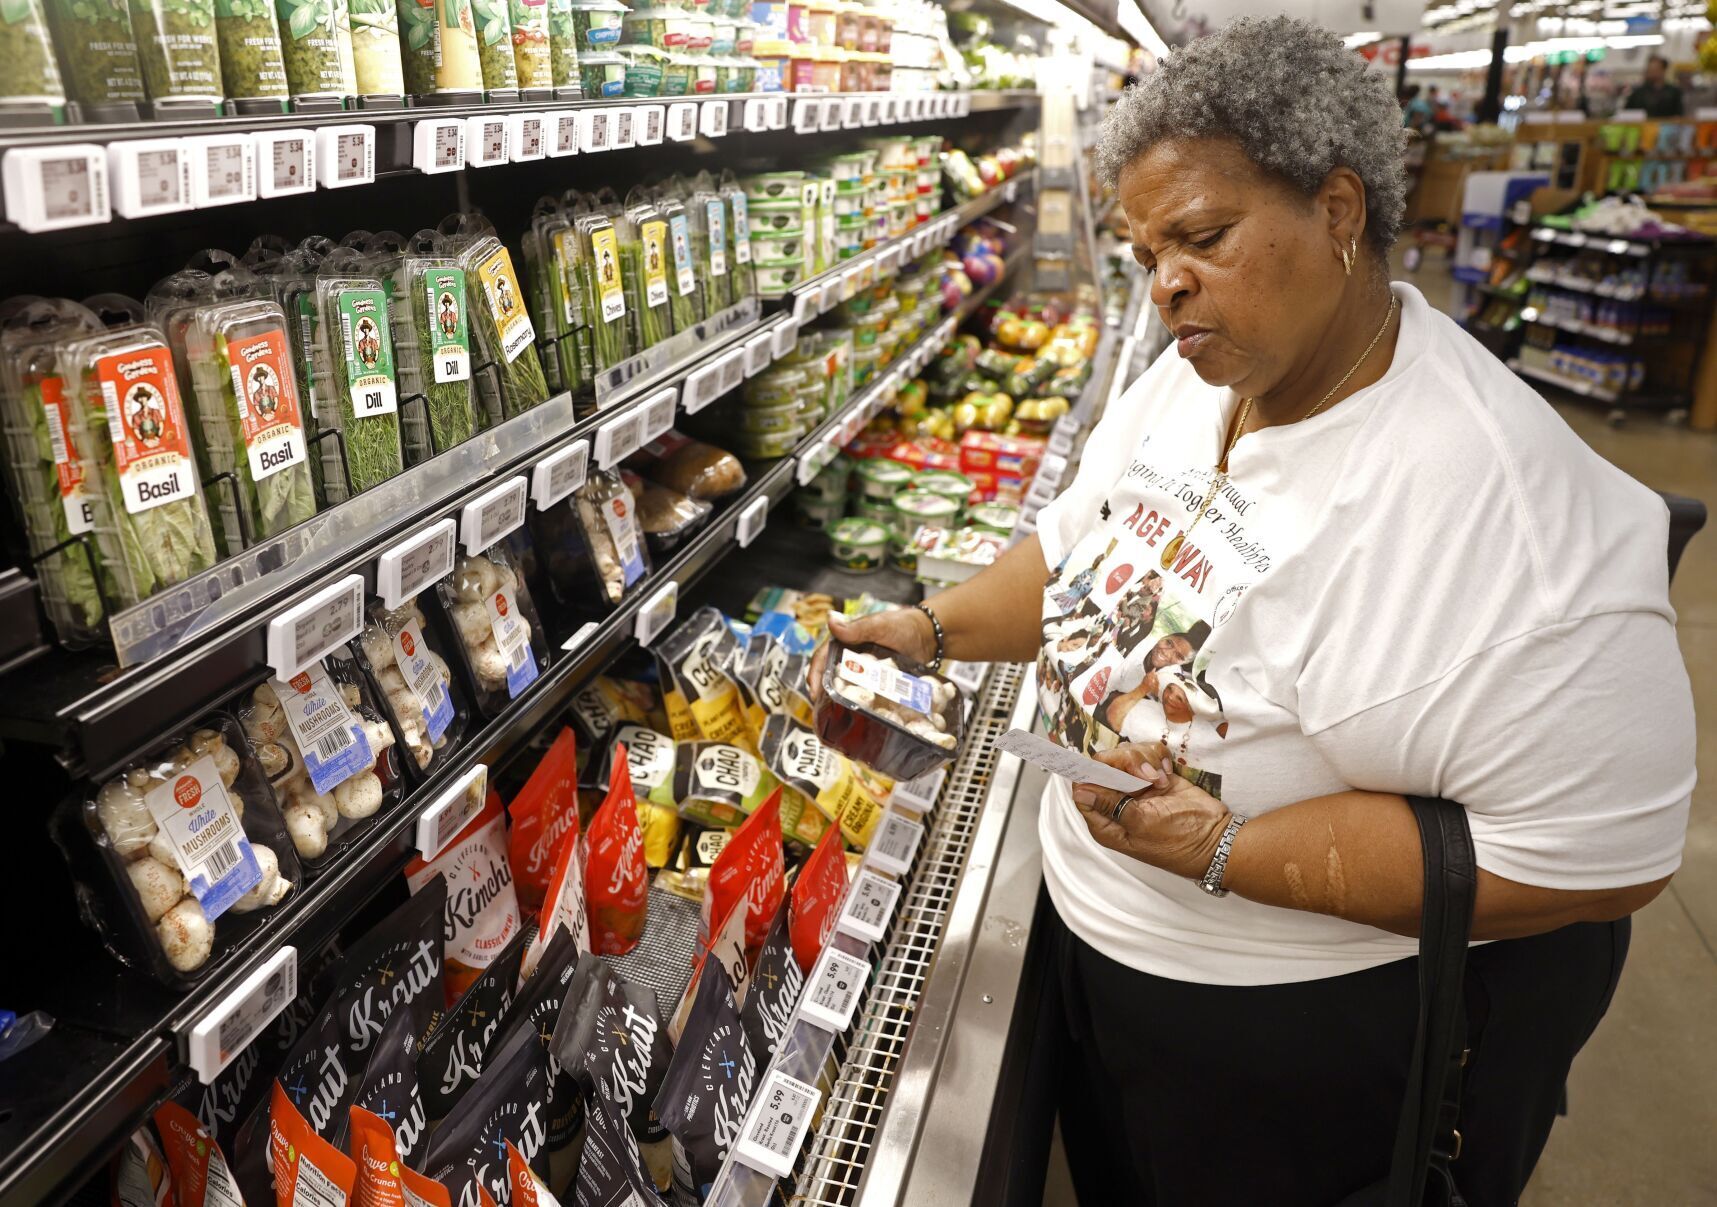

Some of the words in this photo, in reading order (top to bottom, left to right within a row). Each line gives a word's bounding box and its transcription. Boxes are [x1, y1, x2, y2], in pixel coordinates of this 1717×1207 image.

[352, 137, 364, 146] 5.34
[605, 302, 623, 317] Chives
[240, 340, 269, 357] Goodness
[505, 327, 532, 355] Rosemary
[117, 358, 154, 374] Goodness
[246, 347, 272, 363] Gardens
[445, 360, 459, 376] Dill
[359, 376, 386, 387] ORGANIC
[365, 391, 383, 410] Dill
[257, 425, 290, 444] ORGANIC
[135, 454, 178, 472] ORGANIC
[260, 440, 293, 471] Basil
[138, 472, 180, 503] Basil
[427, 538, 444, 554] 2.79
[1122, 502, 1171, 548] AGE
[1173, 541, 1213, 594] WAY
[329, 597, 349, 616] 2.79
[298, 702, 341, 734] MUSHROOMS
[303, 697, 327, 717] White
[716, 748, 740, 786] CHAO
[179, 785, 201, 806] FRESH
[188, 808, 217, 834] White
[843, 796, 865, 828] CREAMY
[851, 801, 875, 834] ORIGINAL
[181, 812, 231, 856] MUSHROOMS
[449, 843, 488, 880] CLEVELAND
[444, 855, 512, 942] Kimchi
[862, 883, 872, 897] 5.99
[475, 934, 502, 949] CLASSIC
[501, 912, 514, 941] KIMCHI
[827, 962, 839, 979] 5.99
[350, 939, 440, 1052] Kraut
[757, 946, 803, 1054] Kraut
[612, 1004, 658, 1118] Kraut
[701, 1025, 731, 1091] CLEVELAND
[361, 1072, 402, 1109] VELAND
[714, 1020, 757, 1161] Kraut
[770, 1089, 785, 1111] 5.99
[687, 1094, 700, 1122] PROBIOTICS
[170, 1120, 195, 1146] Crave
[271, 1119, 289, 1151] Crave
[466, 1102, 518, 1167] CLEVELAND
[753, 1122, 764, 1142] Cleveland
[362, 1144, 388, 1172] Crave
[208, 1176, 234, 1198] Calories
[300, 1155, 326, 1184] Nutrition
[326, 1181, 345, 1199] Facts
[370, 1174, 397, 1188] Crunch
[296, 1183, 320, 1205] Calories
[523, 1193, 535, 1204] The
